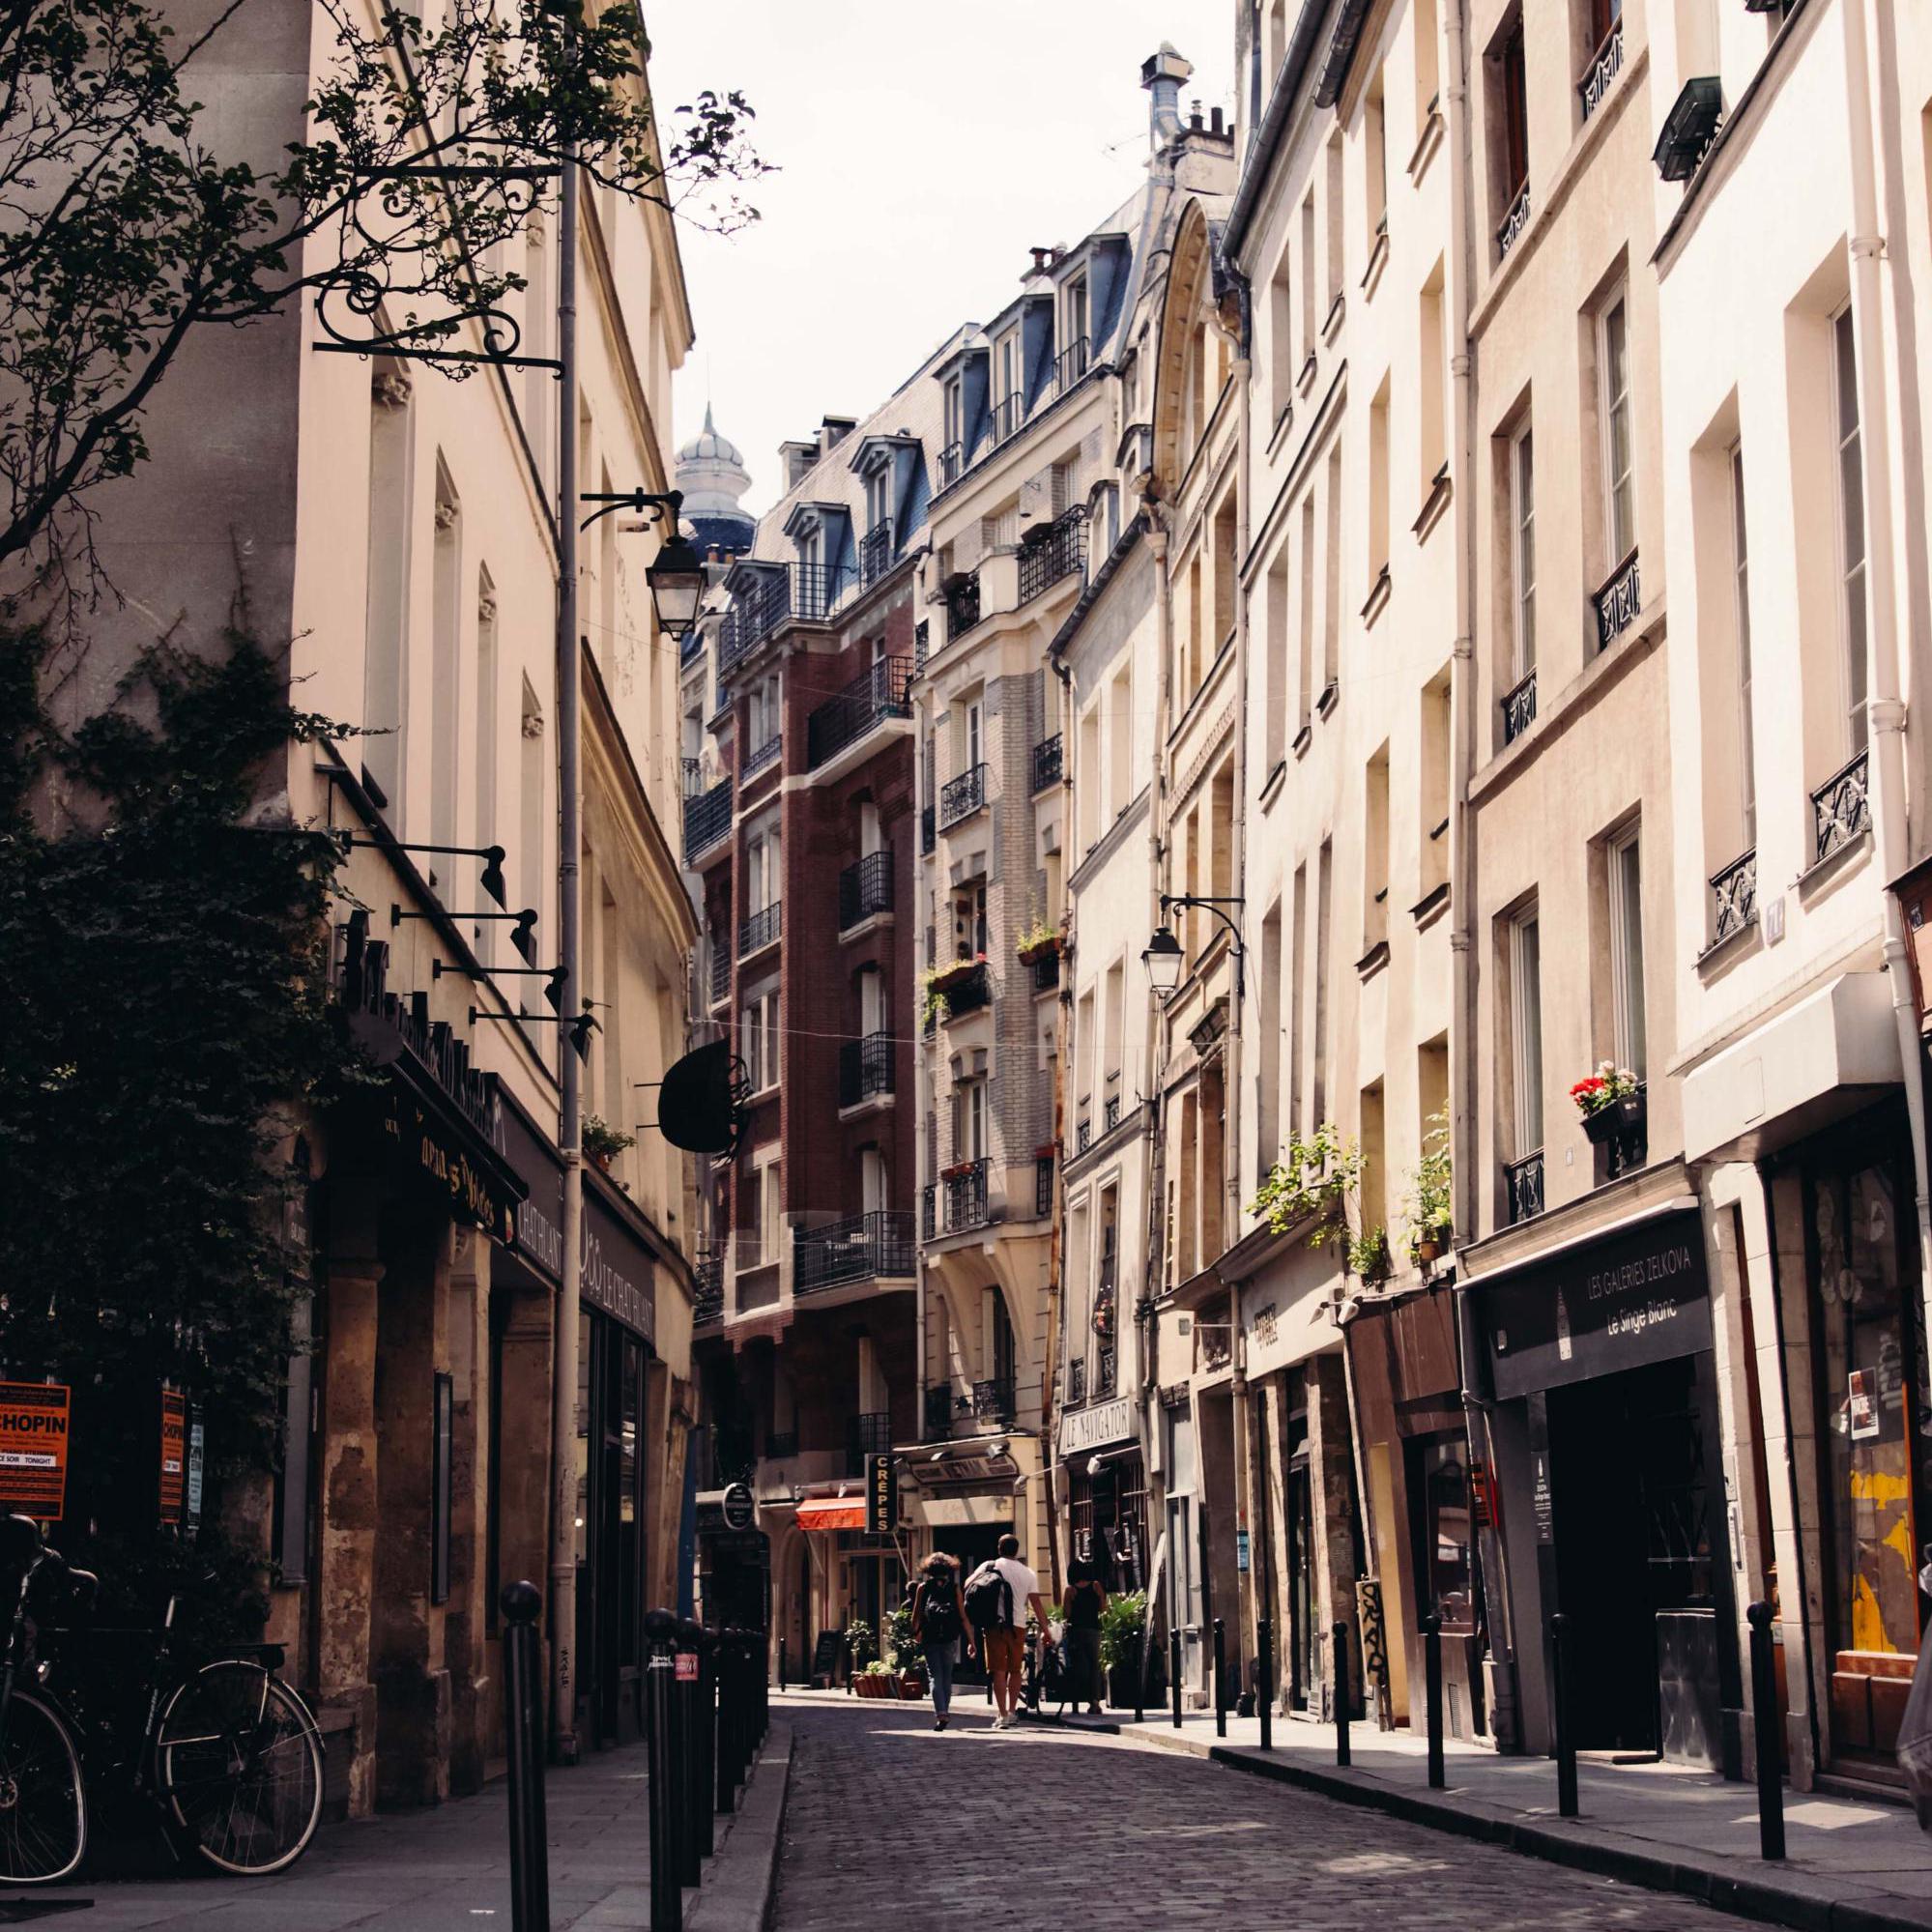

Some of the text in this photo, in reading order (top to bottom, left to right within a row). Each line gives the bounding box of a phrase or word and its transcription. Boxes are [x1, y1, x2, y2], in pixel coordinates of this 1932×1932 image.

[1587, 1246, 1690, 1300] LES GALERIES ZELKOVA
[1607, 1299, 1677, 1336] Le Singe Blanc
[1067, 1402, 1128, 1448] LE NAVIGATOR
[25, 1456, 51, 1465] TONIGHT
